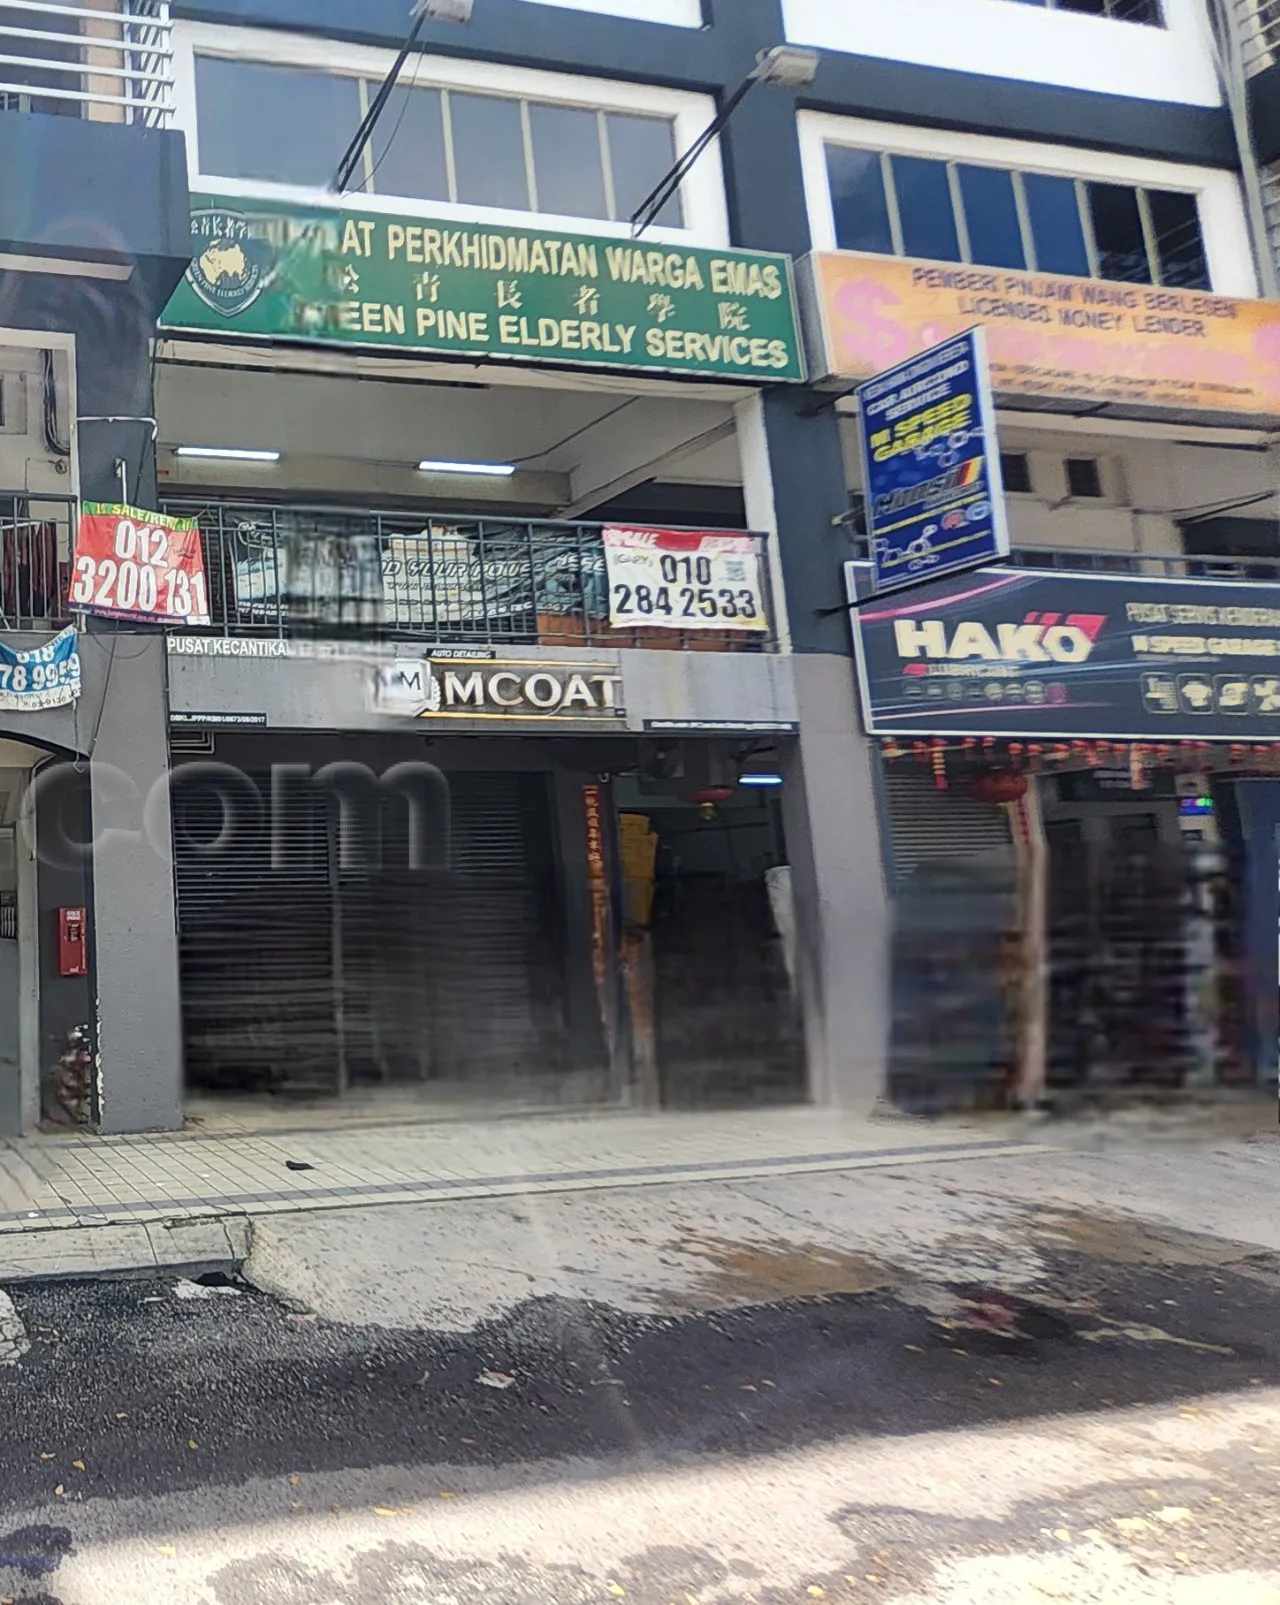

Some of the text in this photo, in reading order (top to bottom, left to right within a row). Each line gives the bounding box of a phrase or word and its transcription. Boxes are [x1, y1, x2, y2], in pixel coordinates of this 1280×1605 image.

[387, 223, 599, 279] PERKHIDMATAN
[605, 246, 704, 291] WARGA
[710, 259, 782, 300] EMAS
[1058, 308, 1123, 331] MONEY
[416, 307, 490, 342] PINE
[499, 315, 636, 353] ELDERLY
[645, 327, 789, 369] SERVICES
[115, 519, 168, 568] 012
[73, 555, 209, 616] 3200 131
[659, 554, 712, 586] 010
[614, 583, 757, 619] 284 2533
[168, 637, 210, 654] PUSAT
[431, 649, 452, 658] AUTO
[442, 671, 623, 708] MCOAT
